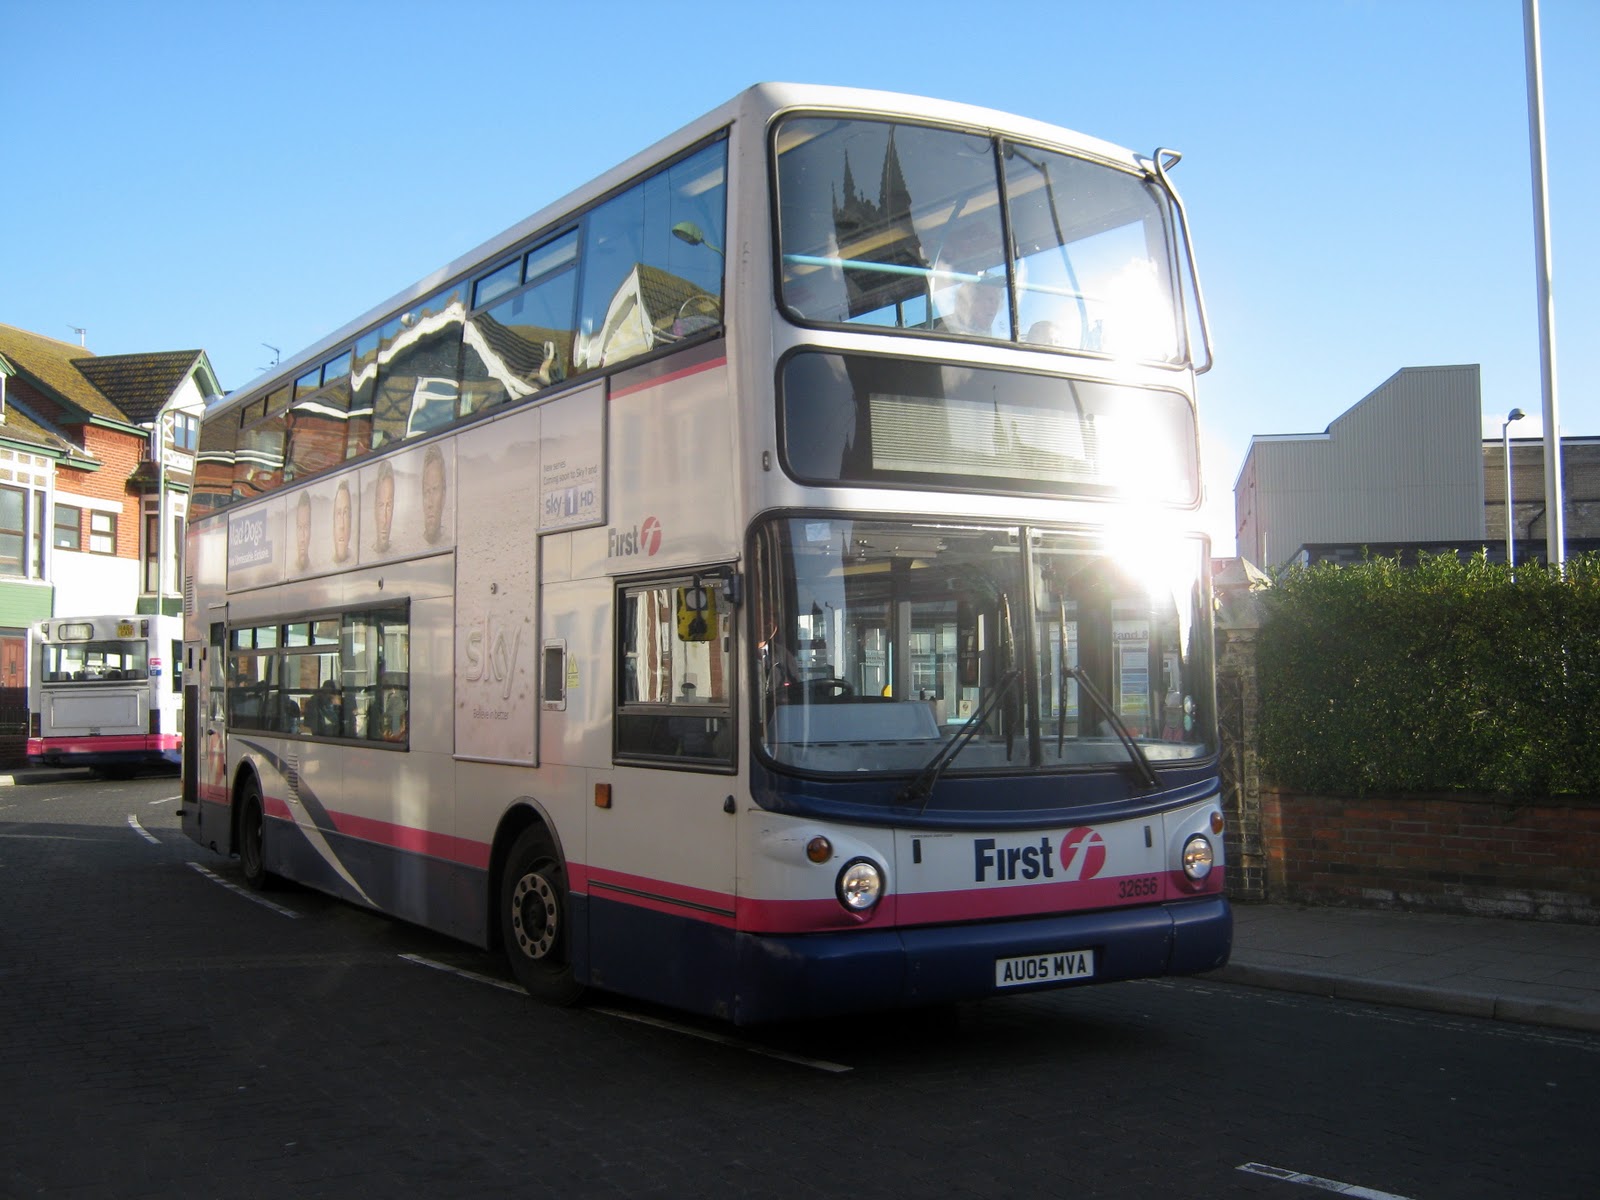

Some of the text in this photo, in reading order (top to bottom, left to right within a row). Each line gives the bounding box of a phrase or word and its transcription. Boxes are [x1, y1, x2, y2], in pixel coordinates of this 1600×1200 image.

[545, 492, 563, 517] sky
[580, 490, 594, 507] HD
[244, 519, 263, 546] Dogs
[607, 525, 639, 558] First
[1112, 629, 1139, 641] tand
[974, 837, 1054, 882] First
[1118, 876, 1158, 899] 32656
[1003, 953, 1087, 982] AU05 MVA
